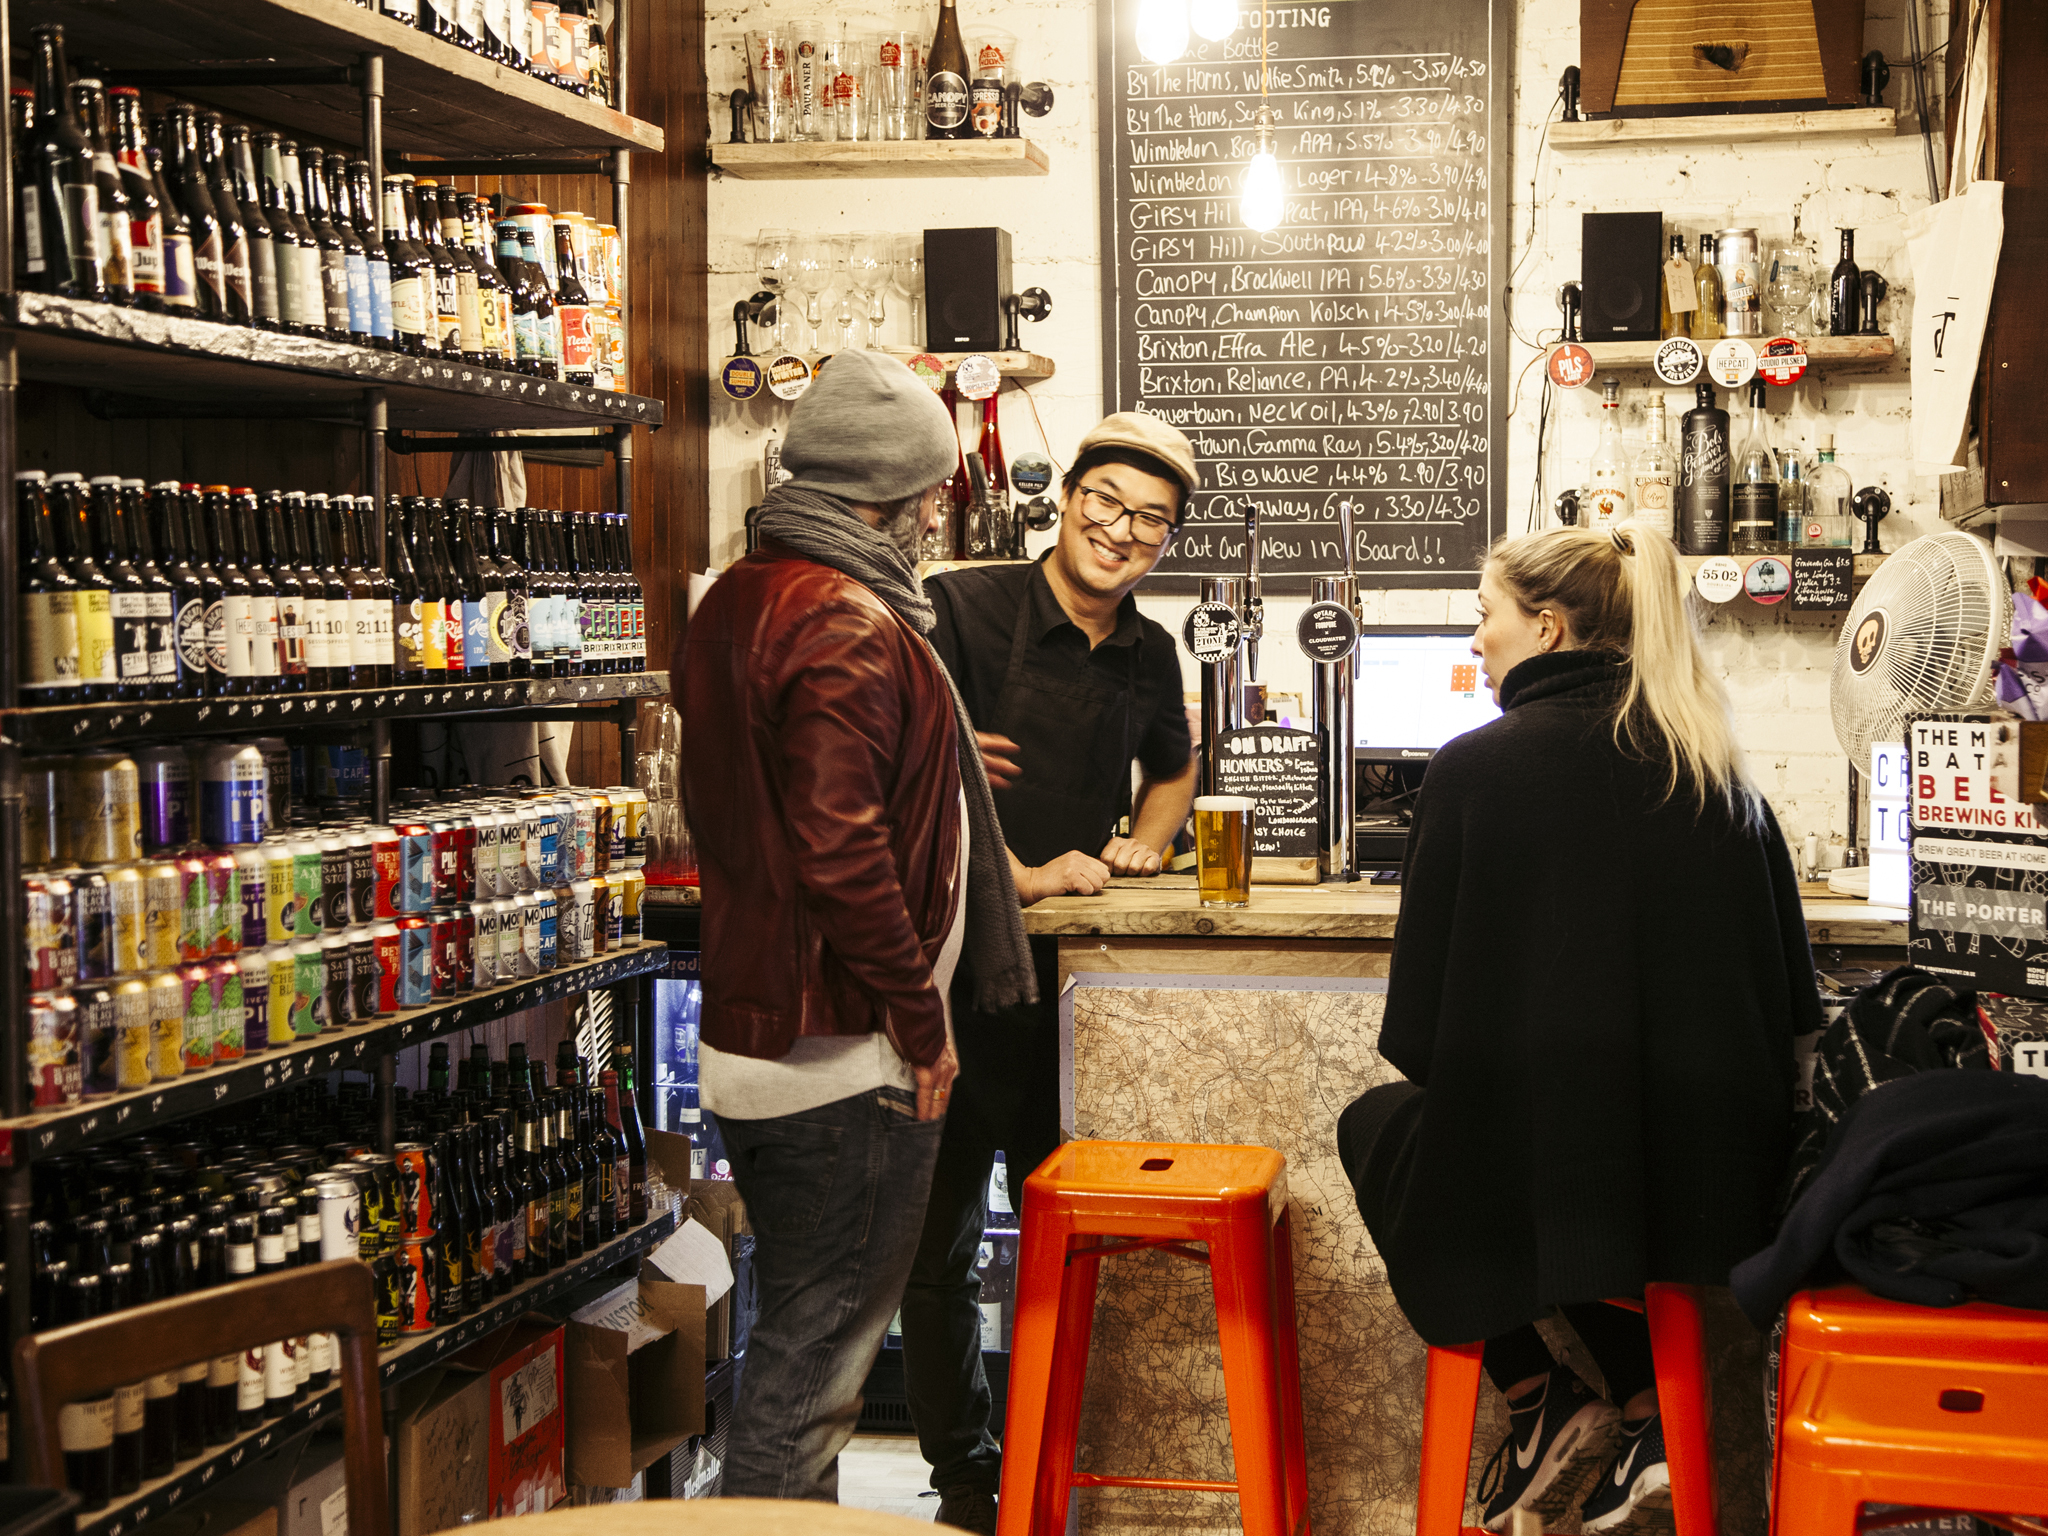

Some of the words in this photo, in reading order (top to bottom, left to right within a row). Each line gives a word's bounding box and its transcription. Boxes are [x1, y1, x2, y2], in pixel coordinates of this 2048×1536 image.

[1224, 36, 1279, 60] Bottle
[803, 61, 813, 117] PAULANER
[1127, 69, 1149, 99] By
[1152, 67, 1181, 95] The
[927, 92, 969, 105] CANOPY
[1127, 106, 1149, 134] By
[1155, 103, 1183, 130] The
[1130, 169, 1232, 195] Wimbledon
[1230, 265, 1313, 293] Brockwell
[1727, 286, 1754, 300] DRIFTER
[1215, 301, 1301, 326] Champion
[1218, 332, 1267, 360] Effra
[1558, 355, 1584, 378] PILS
[1718, 358, 1748, 370] HEPCAT
[1759, 357, 1781, 368] STUDIO
[1781, 355, 1806, 366] PILSNER
[730, 370, 754, 379] DOUBLE
[730, 378, 754, 387] SUMMER
[1665, 364, 1698, 381] BREWERY
[965, 380, 998, 391] HOPSLINGER
[1249, 401, 1307, 424] Neck
[1246, 428, 1318, 456] Gamma
[1216, 462, 1259, 487] Big
[1185, 534, 1213, 559] Out
[1261, 536, 1302, 560] New
[1702, 568, 1719, 581] 55
[1721, 569, 1738, 583] 02
[1313, 609, 1338, 620] OPTARE
[1308, 636, 1347, 645] CLOUDWATER
[1918, 728, 1959, 747] THE
[1220, 758, 1285, 774] HONKERS
[1919, 804, 2007, 828] BREWING
[1271, 827, 1307, 838] CHOICE
[1918, 844, 1944, 855] BREW
[1945, 846, 1977, 858] GREAT
[1978, 848, 2003, 860] BEER
[2005, 851, 2017, 861] AT
[2020, 852, 2046, 864] HOME
[1920, 900, 1957, 917] THE
[1965, 903, 2044, 925] PORTER
[2026, 966, 2046, 974] HOME
